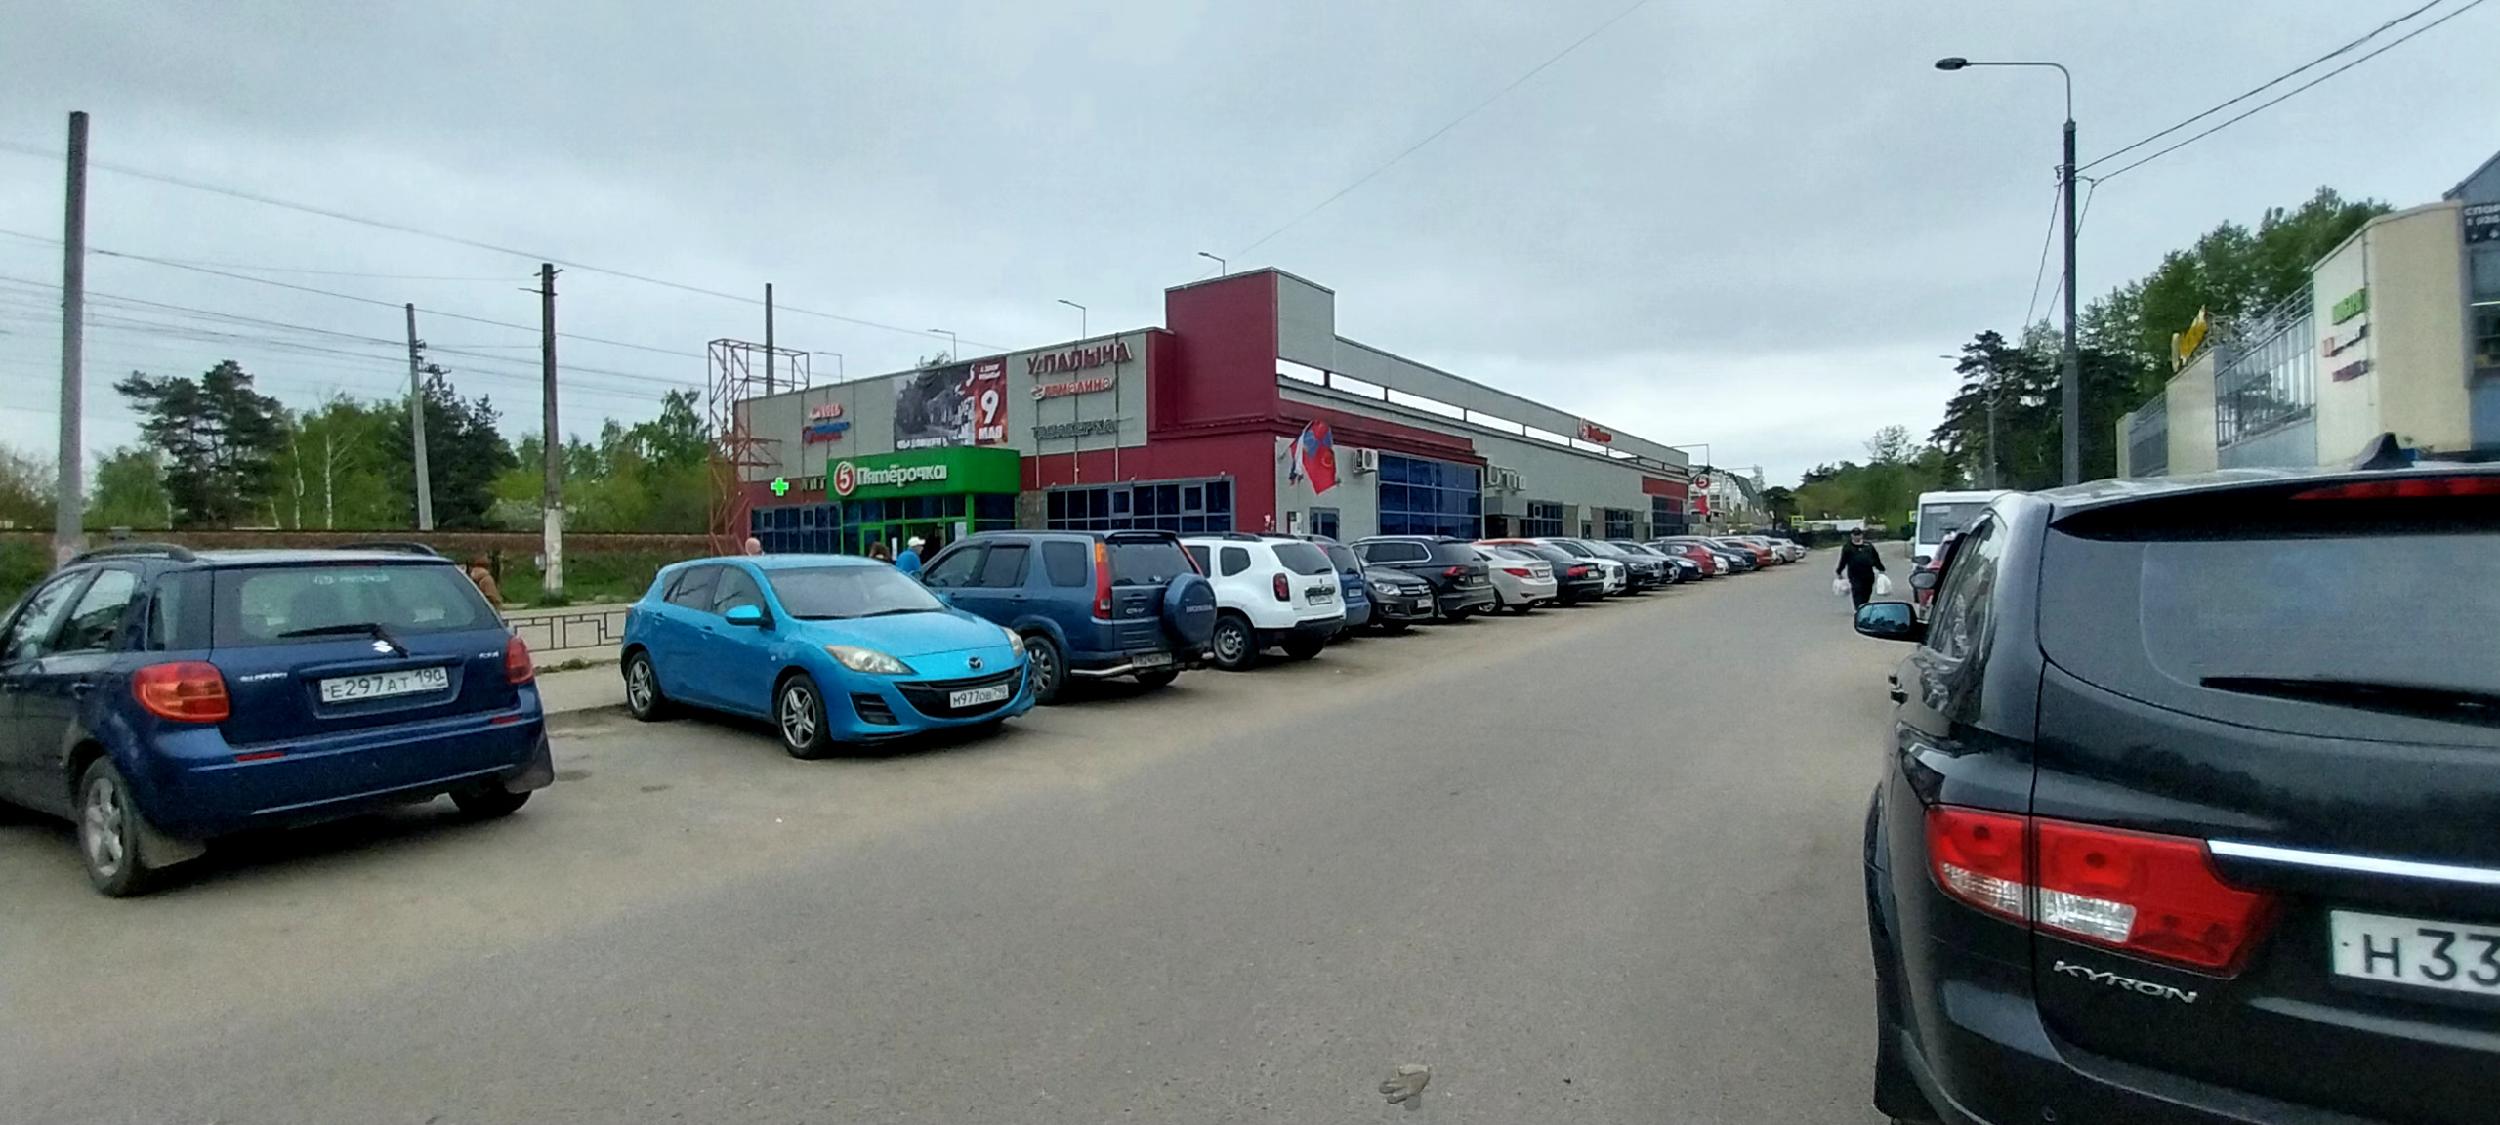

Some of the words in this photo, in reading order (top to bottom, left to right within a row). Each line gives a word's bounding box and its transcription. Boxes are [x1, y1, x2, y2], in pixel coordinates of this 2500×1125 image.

[980, 389, 999, 425] 9
[857, 464, 947, 487] Пятёрочка
[330, 676, 409, 699] Е297АТ
[2361, 927, 2500, 987] Н33
[2053, 959, 2198, 1004] KYRON
